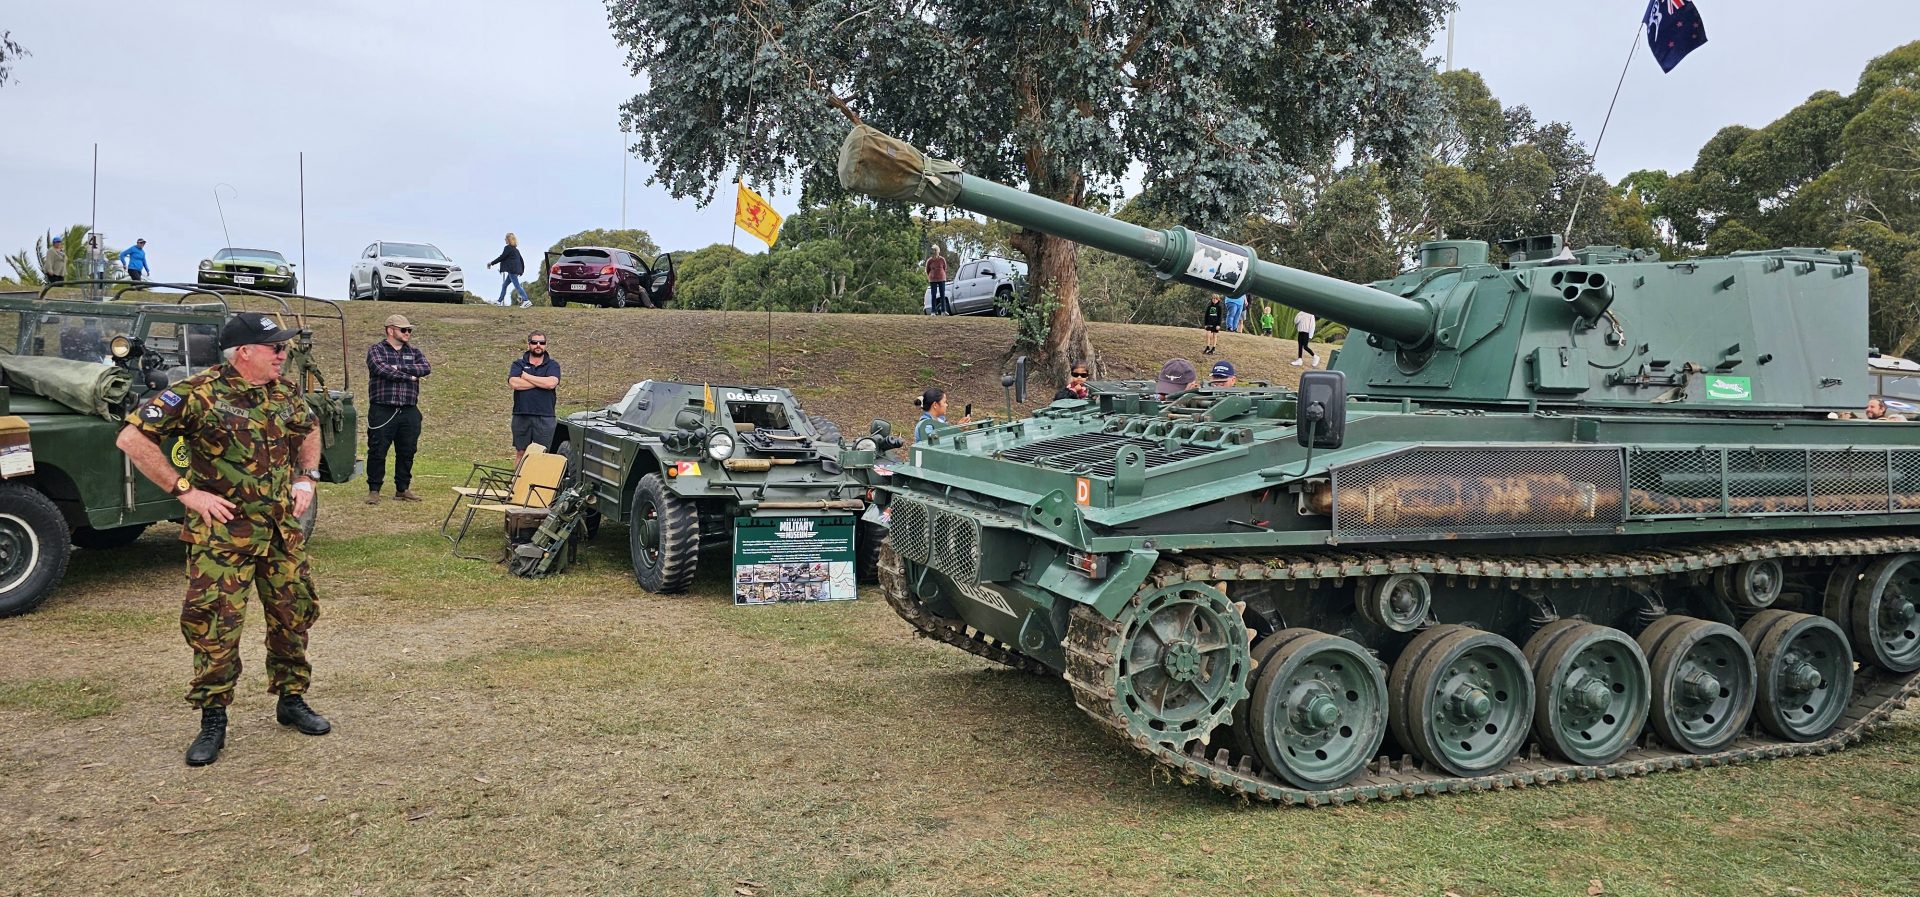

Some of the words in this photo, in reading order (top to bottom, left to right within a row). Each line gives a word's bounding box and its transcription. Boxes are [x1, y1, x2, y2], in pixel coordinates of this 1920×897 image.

[88, 235, 98, 249] 4
[1078, 480, 1088, 502] D
[779, 521, 815, 532] MILITARY
[785, 530, 808, 539] MUSEUM
